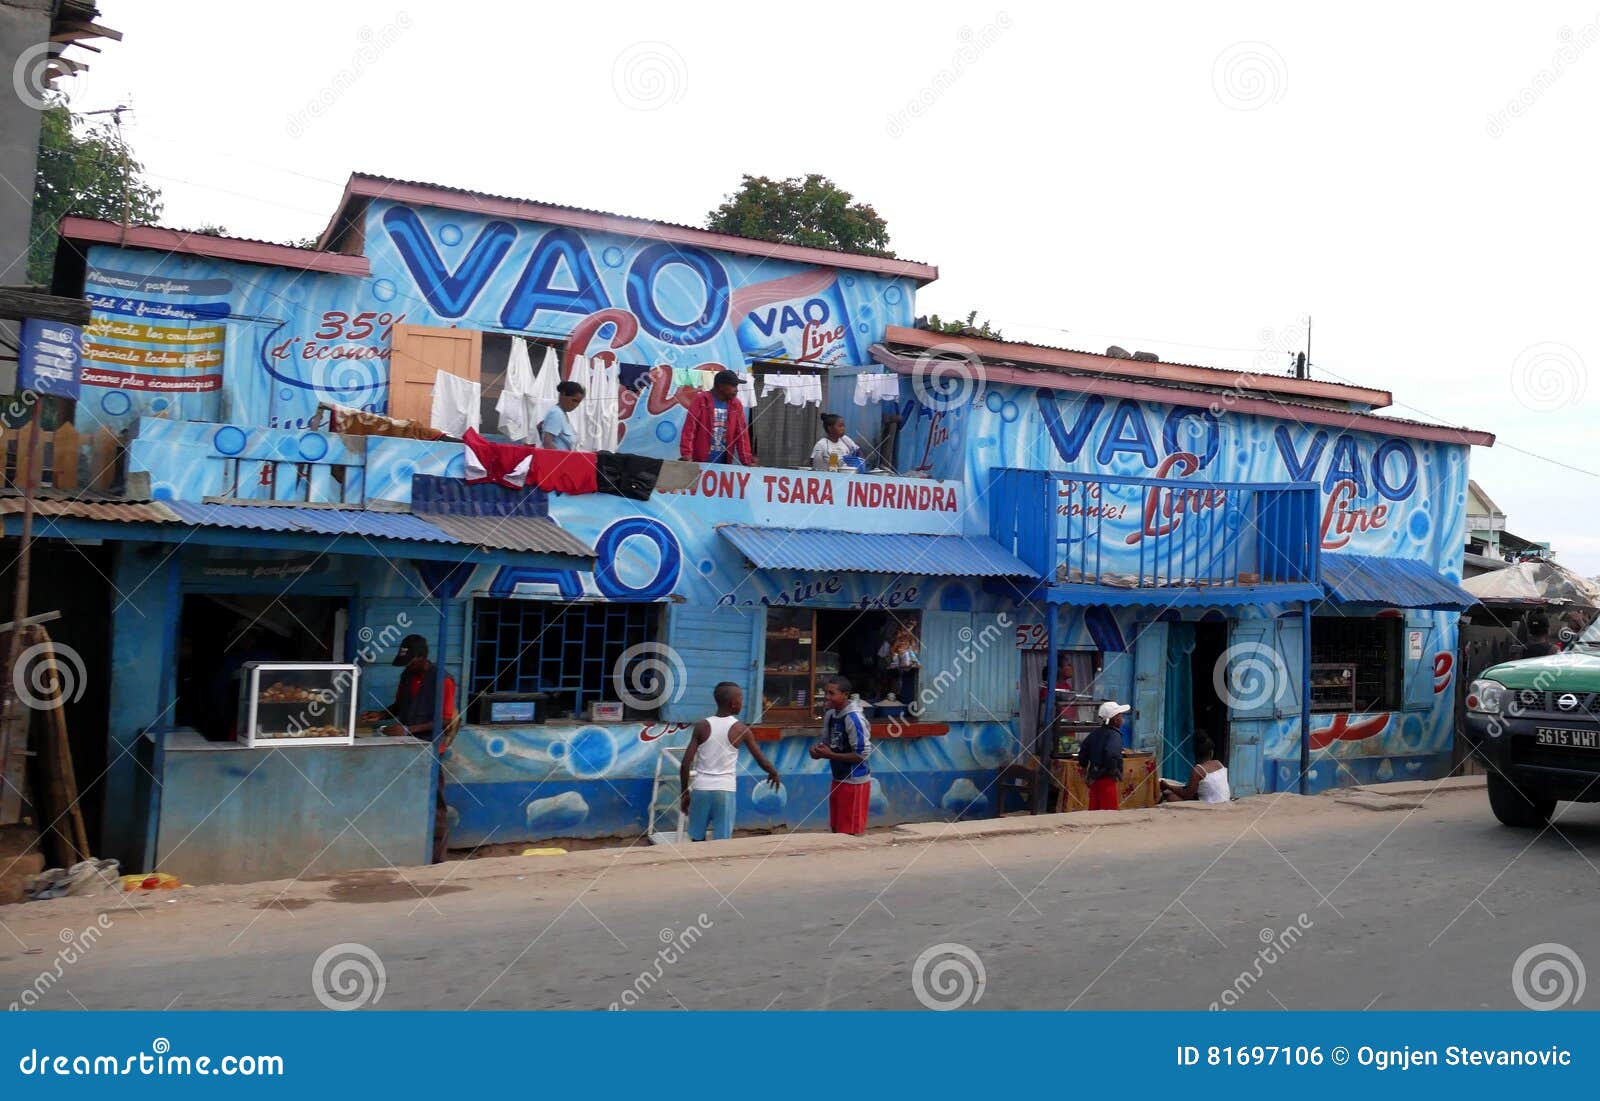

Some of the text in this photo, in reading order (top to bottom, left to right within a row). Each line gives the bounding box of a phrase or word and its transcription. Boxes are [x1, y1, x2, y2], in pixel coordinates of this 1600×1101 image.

[382, 205, 731, 346] VAO
[315, 311, 406, 341] 35%
[748, 298, 830, 337] VAO
[794, 319, 846, 364] Line
[1036, 387, 1219, 469] VAO
[1275, 425, 1417, 501] VAO
[763, 475, 834, 505] TSARA
[847, 480, 958, 513] INDRINDRA
[1320, 480, 1388, 549] Line
[1537, 728, 1568, 745] 5615
